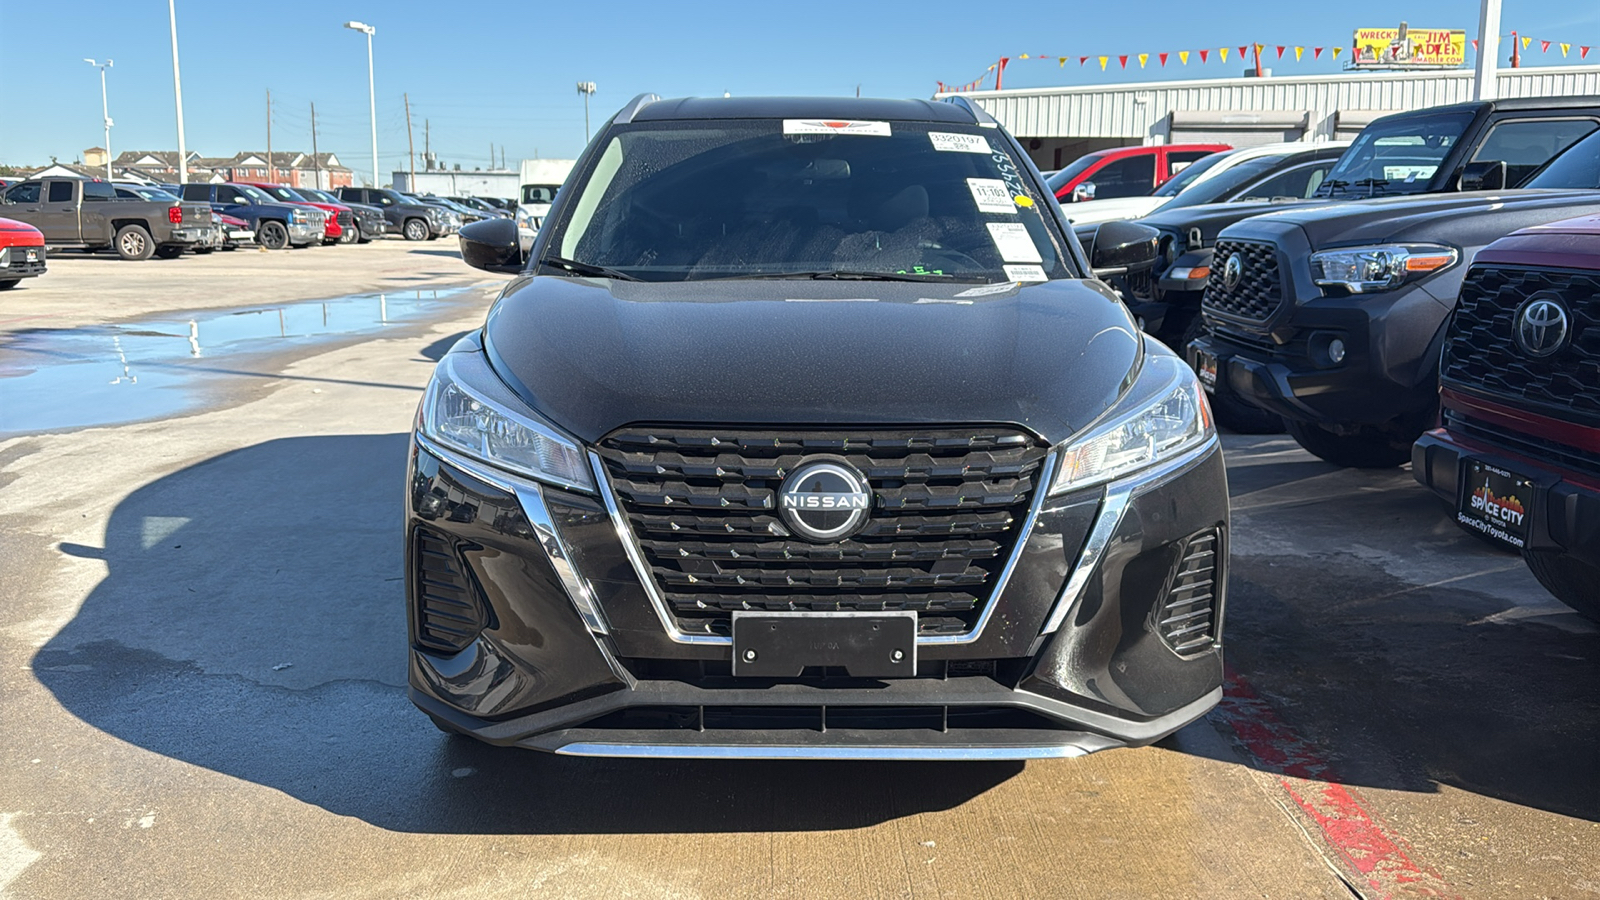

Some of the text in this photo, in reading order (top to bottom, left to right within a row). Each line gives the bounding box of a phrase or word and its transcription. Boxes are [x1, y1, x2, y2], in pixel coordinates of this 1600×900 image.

[1360, 31, 1398, 40] WRECK?
[1426, 32, 1451, 43] JIM
[931, 133, 980, 144] 3320197
[784, 495, 866, 507] NISSAN
[1471, 492, 1524, 526] SPACE CITY
[1490, 517, 1507, 528] TOYOTA
[1457, 511, 1524, 548] SpaceCityToyota.com
